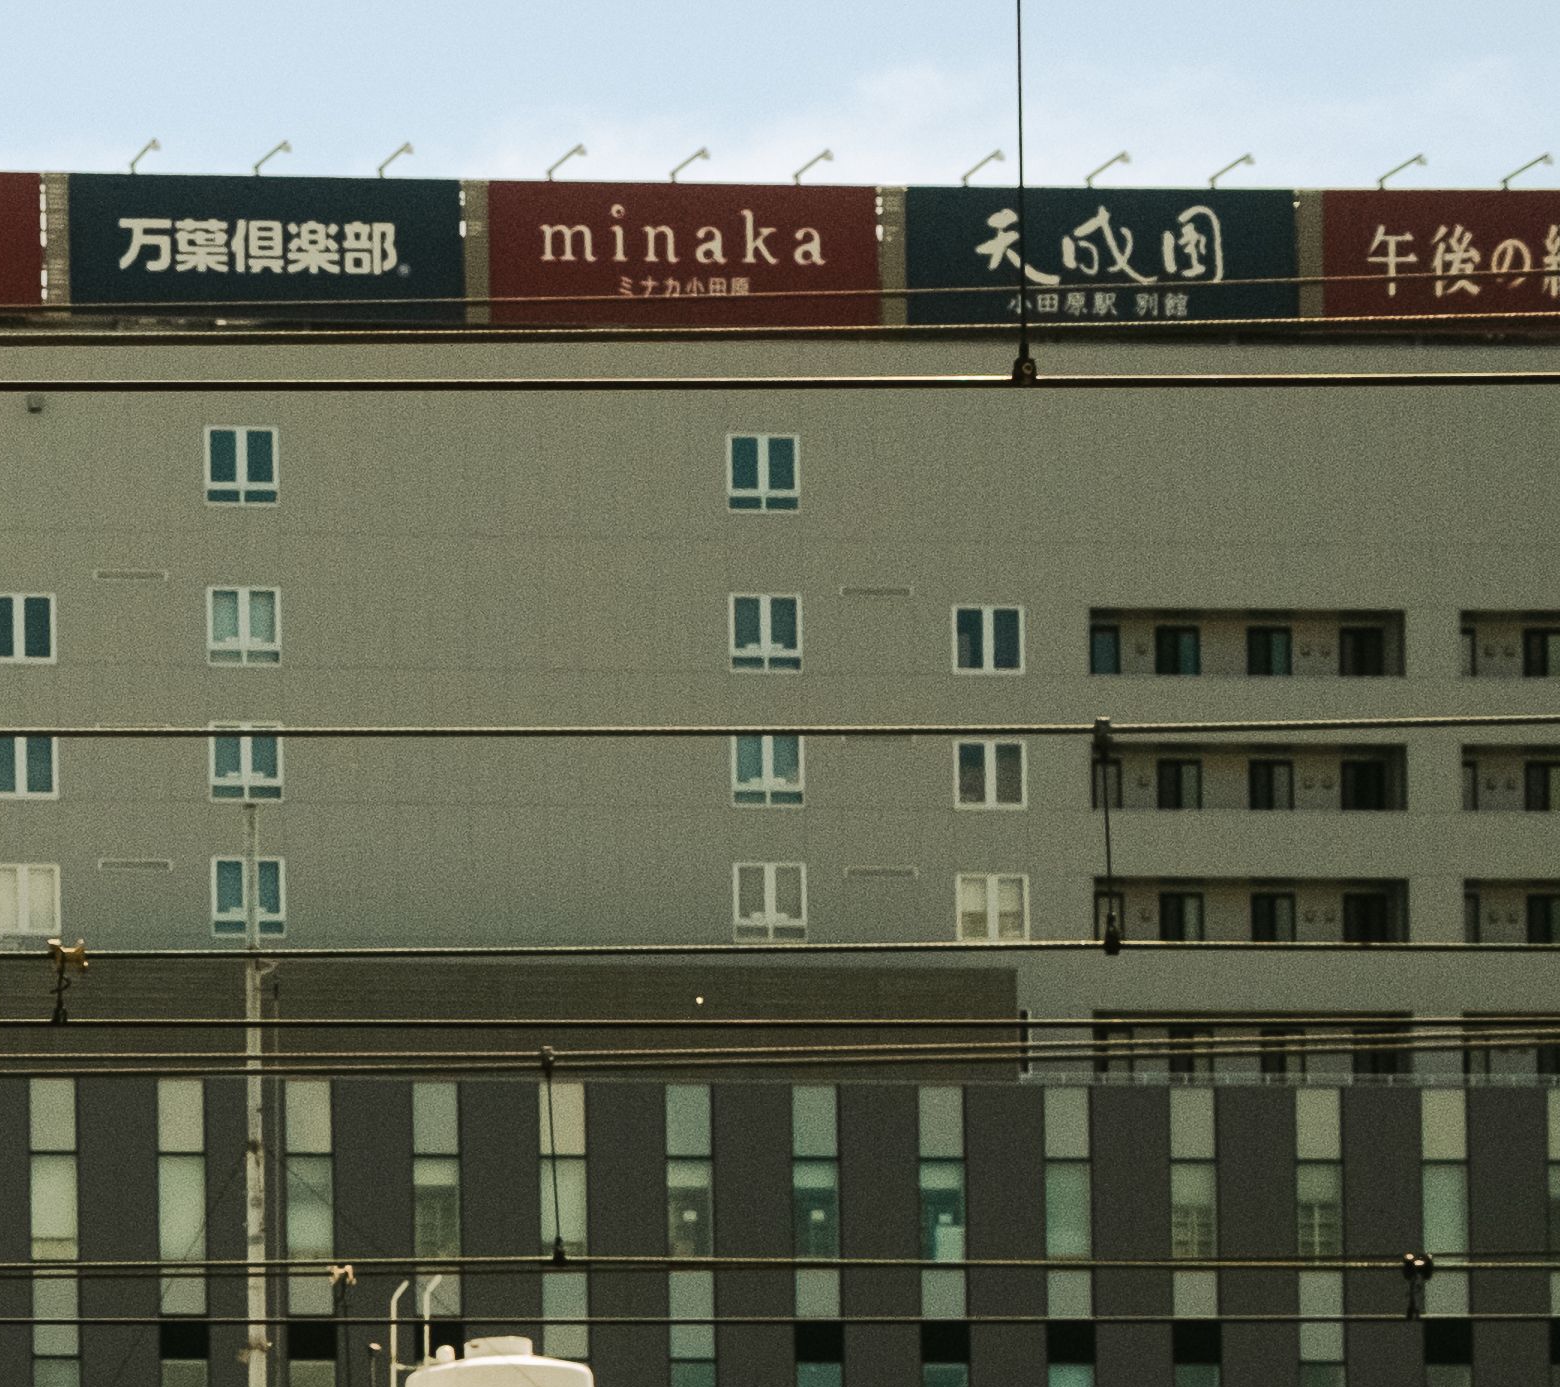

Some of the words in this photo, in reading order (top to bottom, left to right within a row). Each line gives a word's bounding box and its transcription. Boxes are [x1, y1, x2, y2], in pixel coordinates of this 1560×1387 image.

[118, 217, 398, 275] 万葉倶楽部
[540, 203, 826, 266] minaka
